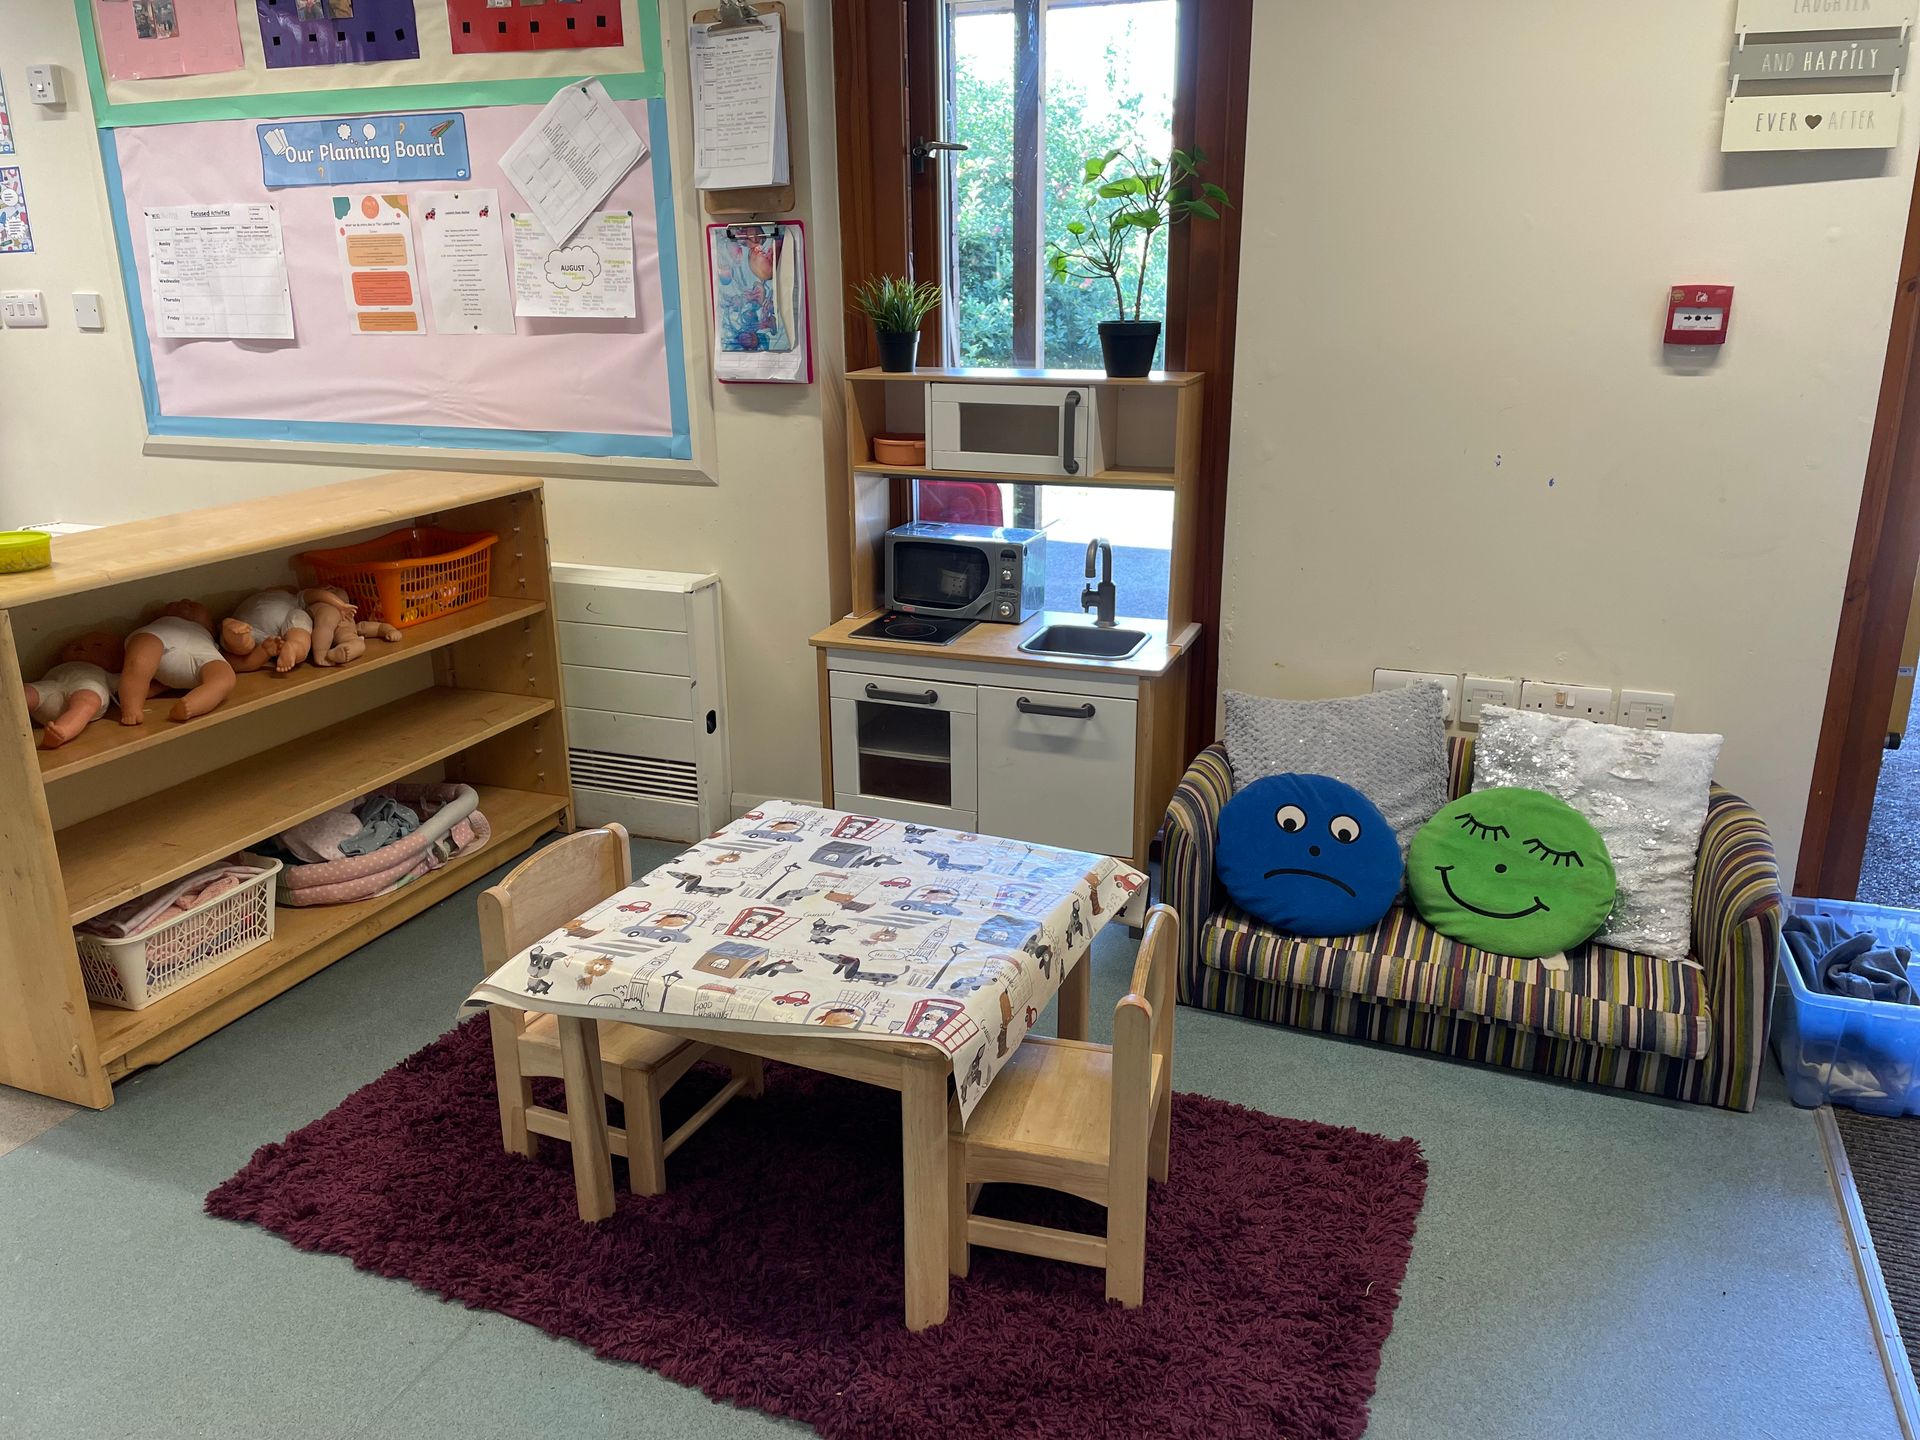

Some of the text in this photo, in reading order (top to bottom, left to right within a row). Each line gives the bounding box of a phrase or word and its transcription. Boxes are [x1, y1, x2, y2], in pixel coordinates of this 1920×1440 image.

[1761, 44, 1880, 73] AND HAPPILY
[1755, 110, 1875, 132] EVER AFTER
[285, 137, 446, 164] Our Planning Board
[190, 210, 210, 218] Focused
[694, 1002, 713, 1011] GOOD
